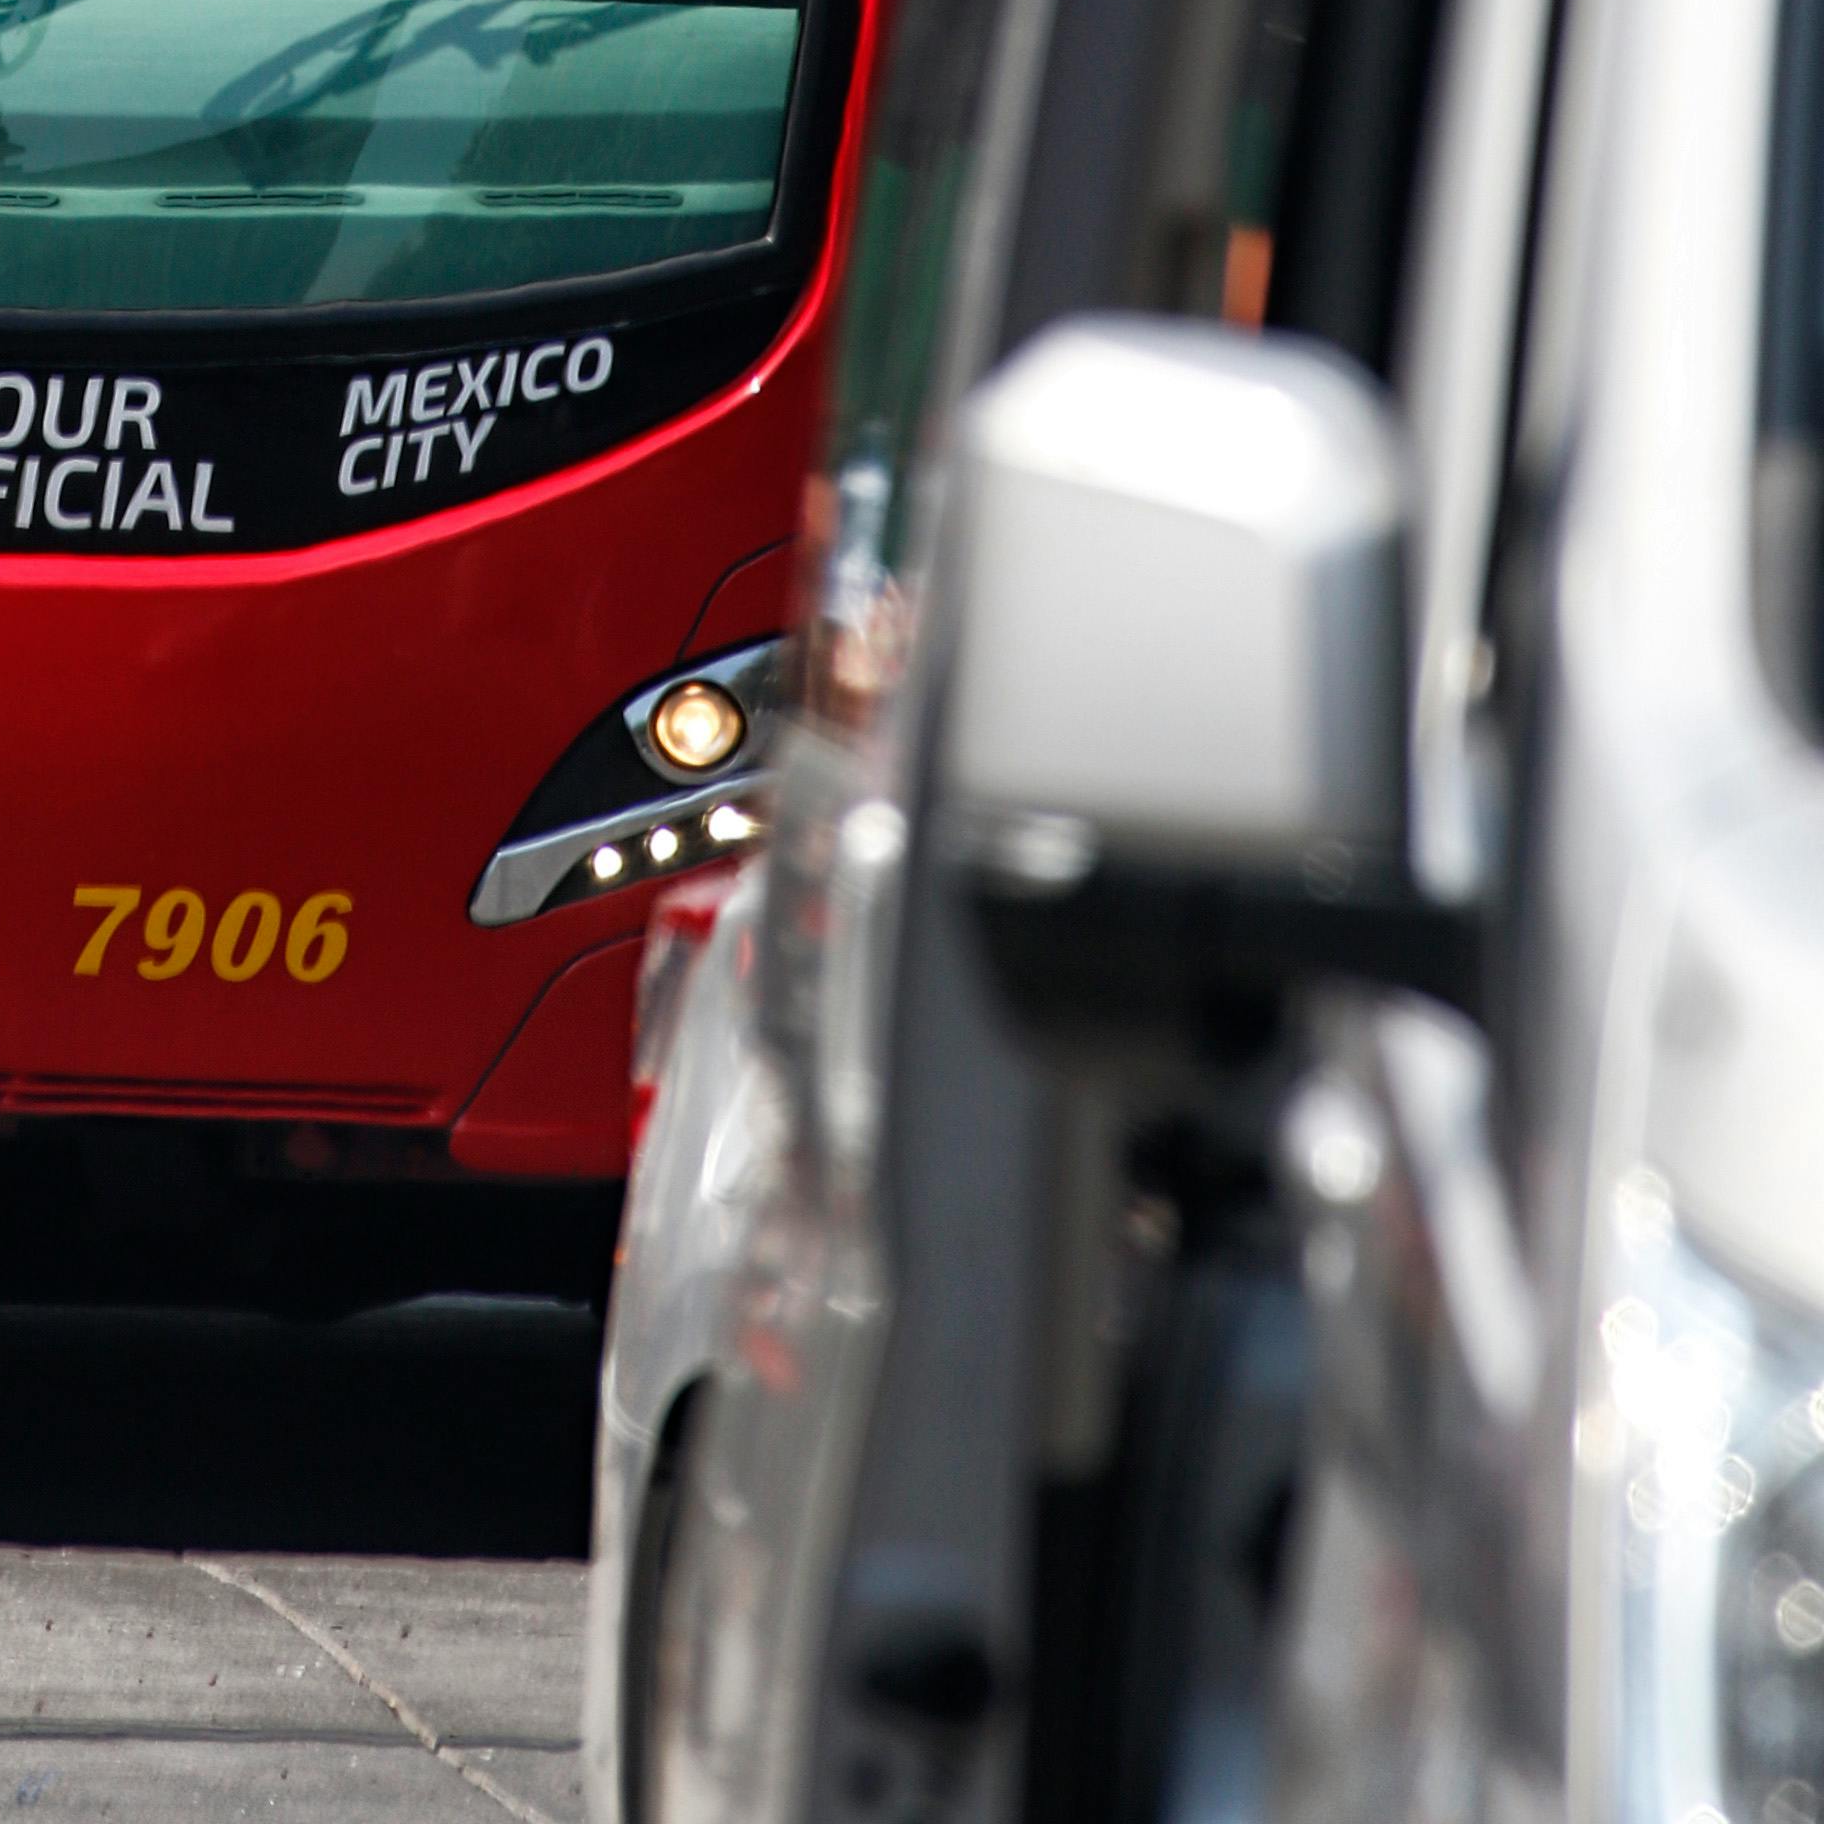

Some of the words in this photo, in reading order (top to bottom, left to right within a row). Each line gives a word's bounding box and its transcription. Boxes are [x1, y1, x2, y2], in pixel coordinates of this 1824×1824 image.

[339, 337, 614, 437] MEXICO
[338, 412, 497, 497] CITY
[73, 885, 353, 983] 7906
